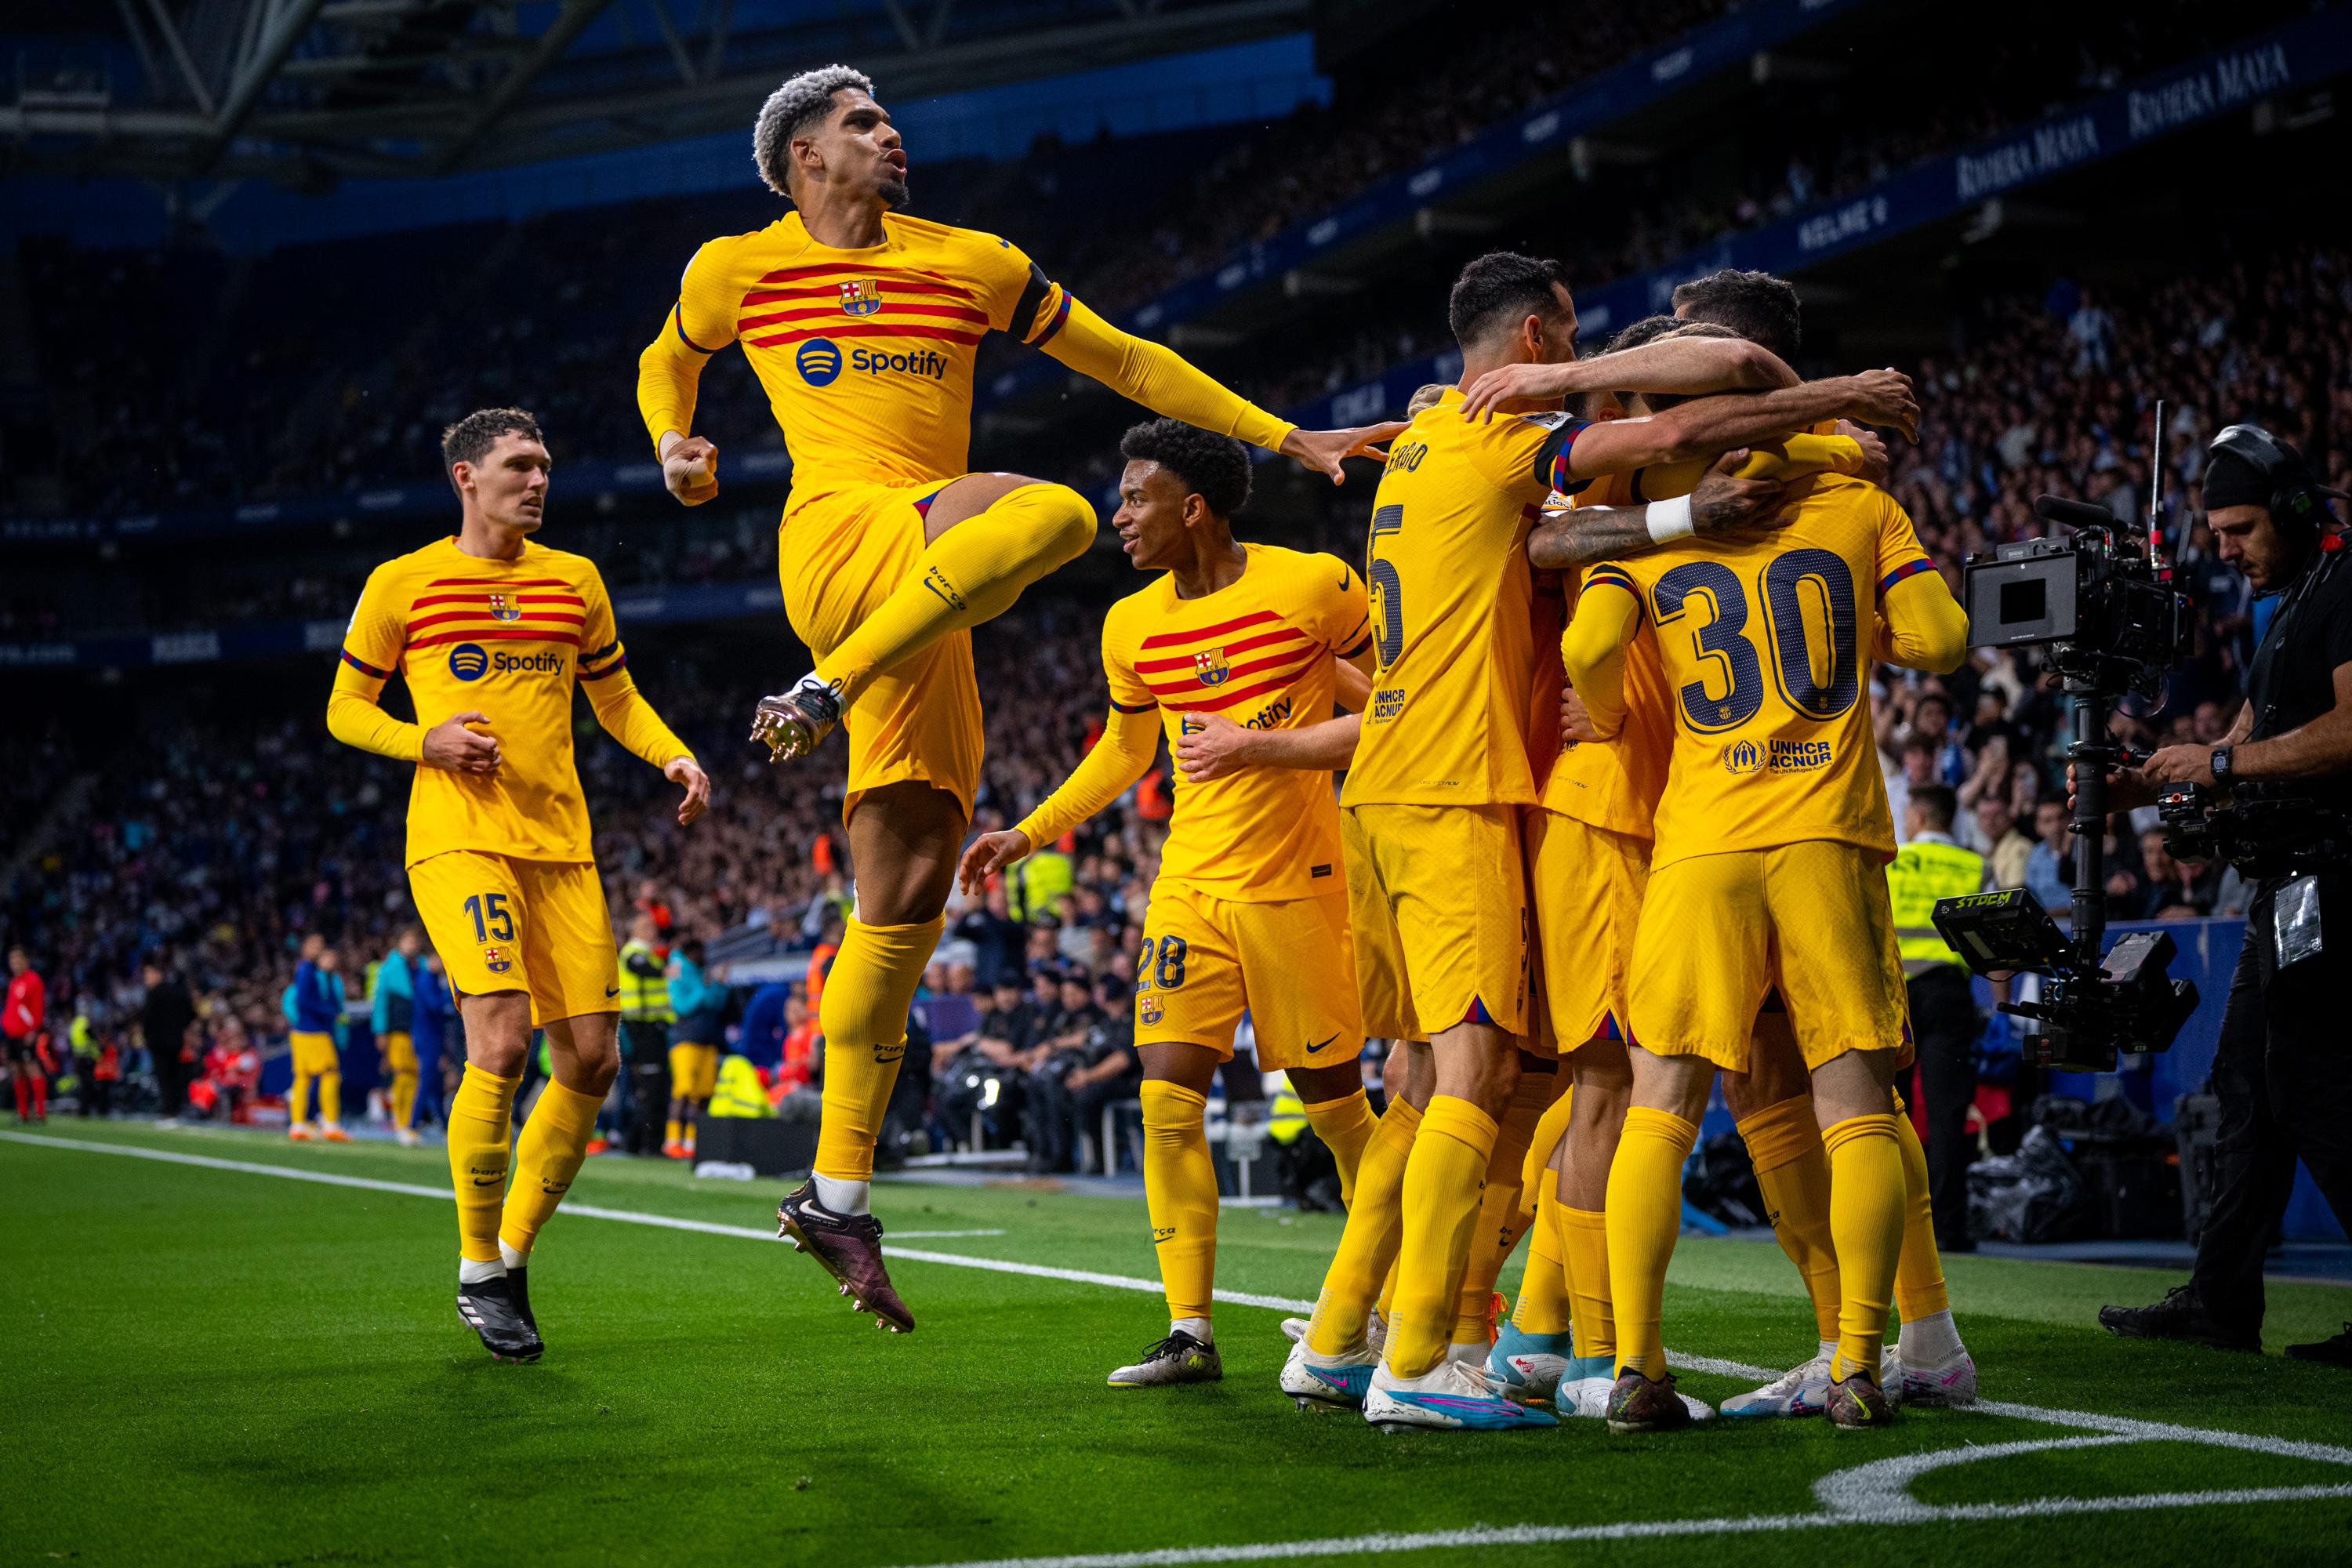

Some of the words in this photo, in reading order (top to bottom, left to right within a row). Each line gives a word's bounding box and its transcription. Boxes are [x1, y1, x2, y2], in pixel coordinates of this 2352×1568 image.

[851, 348, 948, 380] Spotify
[929, 565, 967, 611] barça
[1369, 504, 1404, 673] 5
[1650, 549, 1859, 735] 30
[494, 652, 564, 676] Spotify
[1240, 697, 1291, 730] otify
[1769, 739, 1831, 755] UNHCR
[1769, 752, 1832, 768] ACNUR
[462, 893, 514, 946] 15
[1136, 934, 1188, 993] 28
